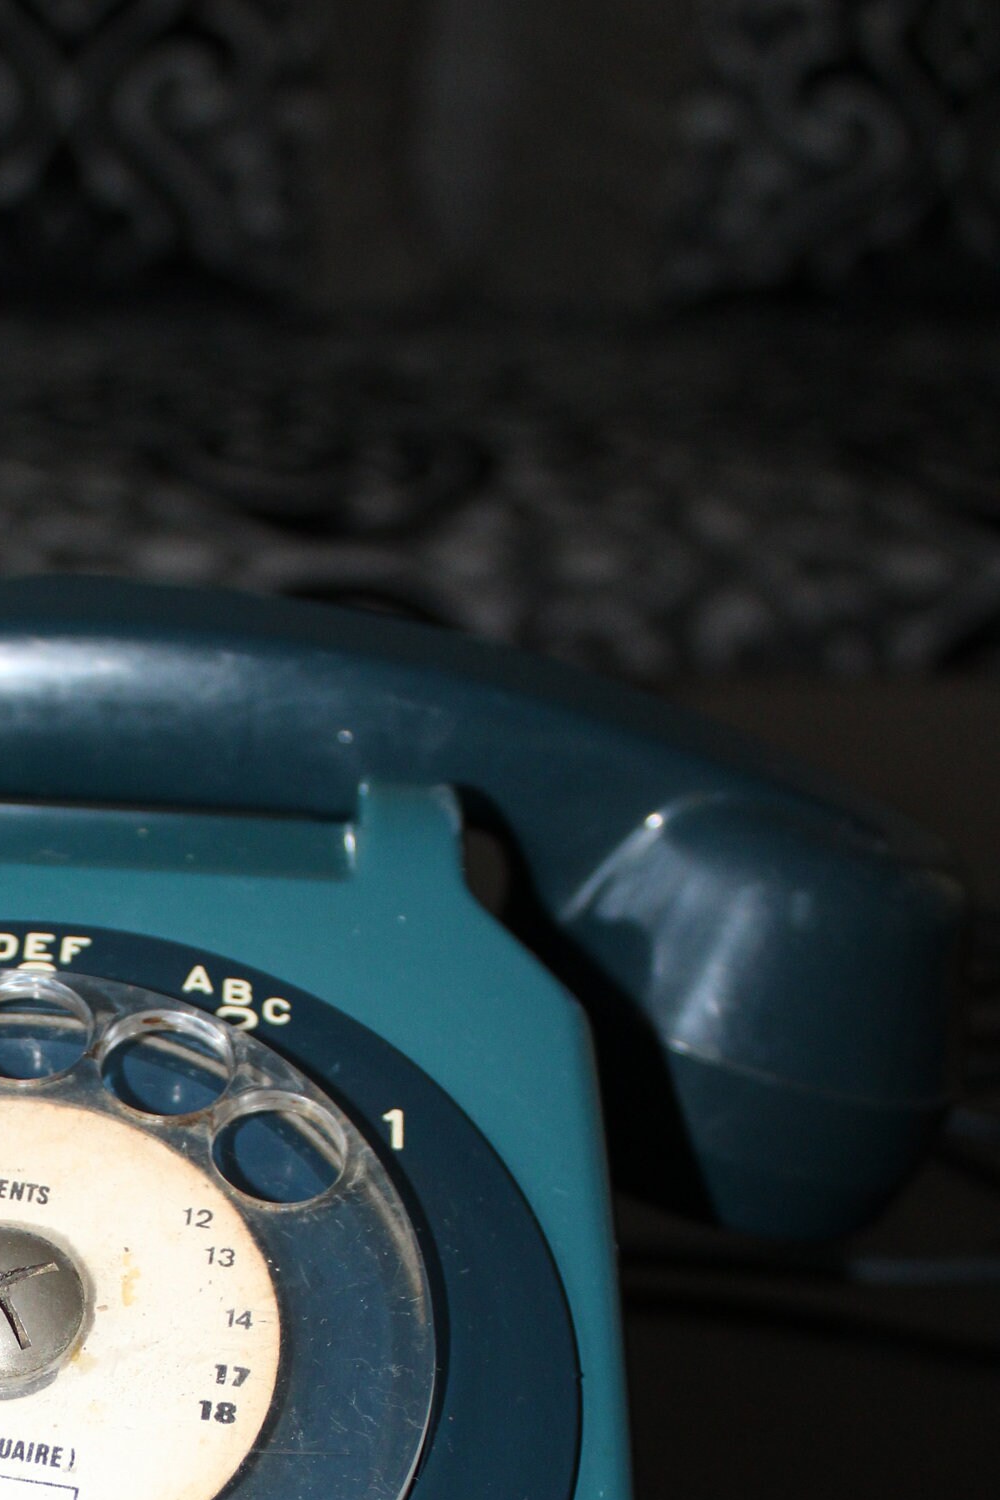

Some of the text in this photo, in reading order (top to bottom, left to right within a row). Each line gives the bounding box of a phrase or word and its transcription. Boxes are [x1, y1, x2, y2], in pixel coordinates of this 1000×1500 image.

[383, 1109, 404, 1150] 1
[184, 1207, 214, 1229] 12
[205, 1247, 236, 1268] 13
[225, 1309, 253, 1330] 14
[214, 1364, 251, 1388] 17
[199, 1400, 237, 1425] 18
